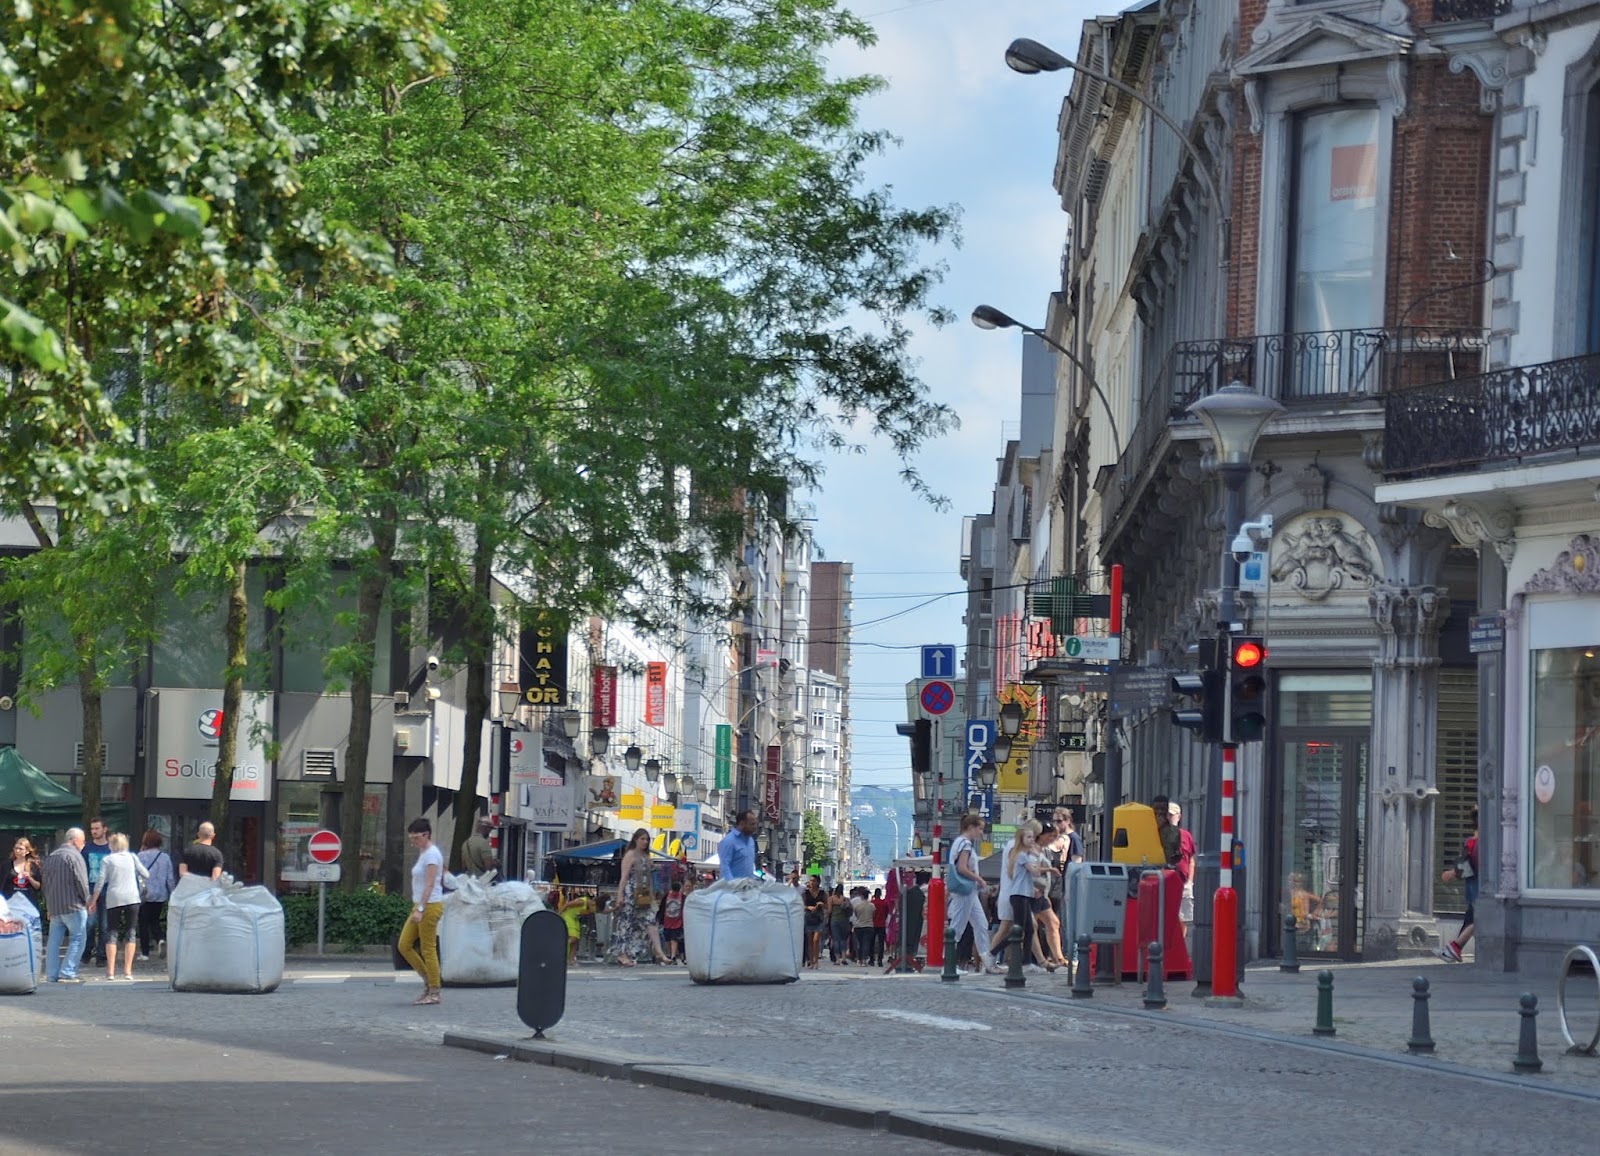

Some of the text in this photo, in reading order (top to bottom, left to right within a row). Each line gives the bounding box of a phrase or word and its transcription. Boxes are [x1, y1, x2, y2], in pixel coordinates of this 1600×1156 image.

[526, 687, 559, 703] OR
[649, 664, 664, 724] BASIC-FIT
[600, 694, 610, 716] chat
[165, 759, 258, 779] Soliris
